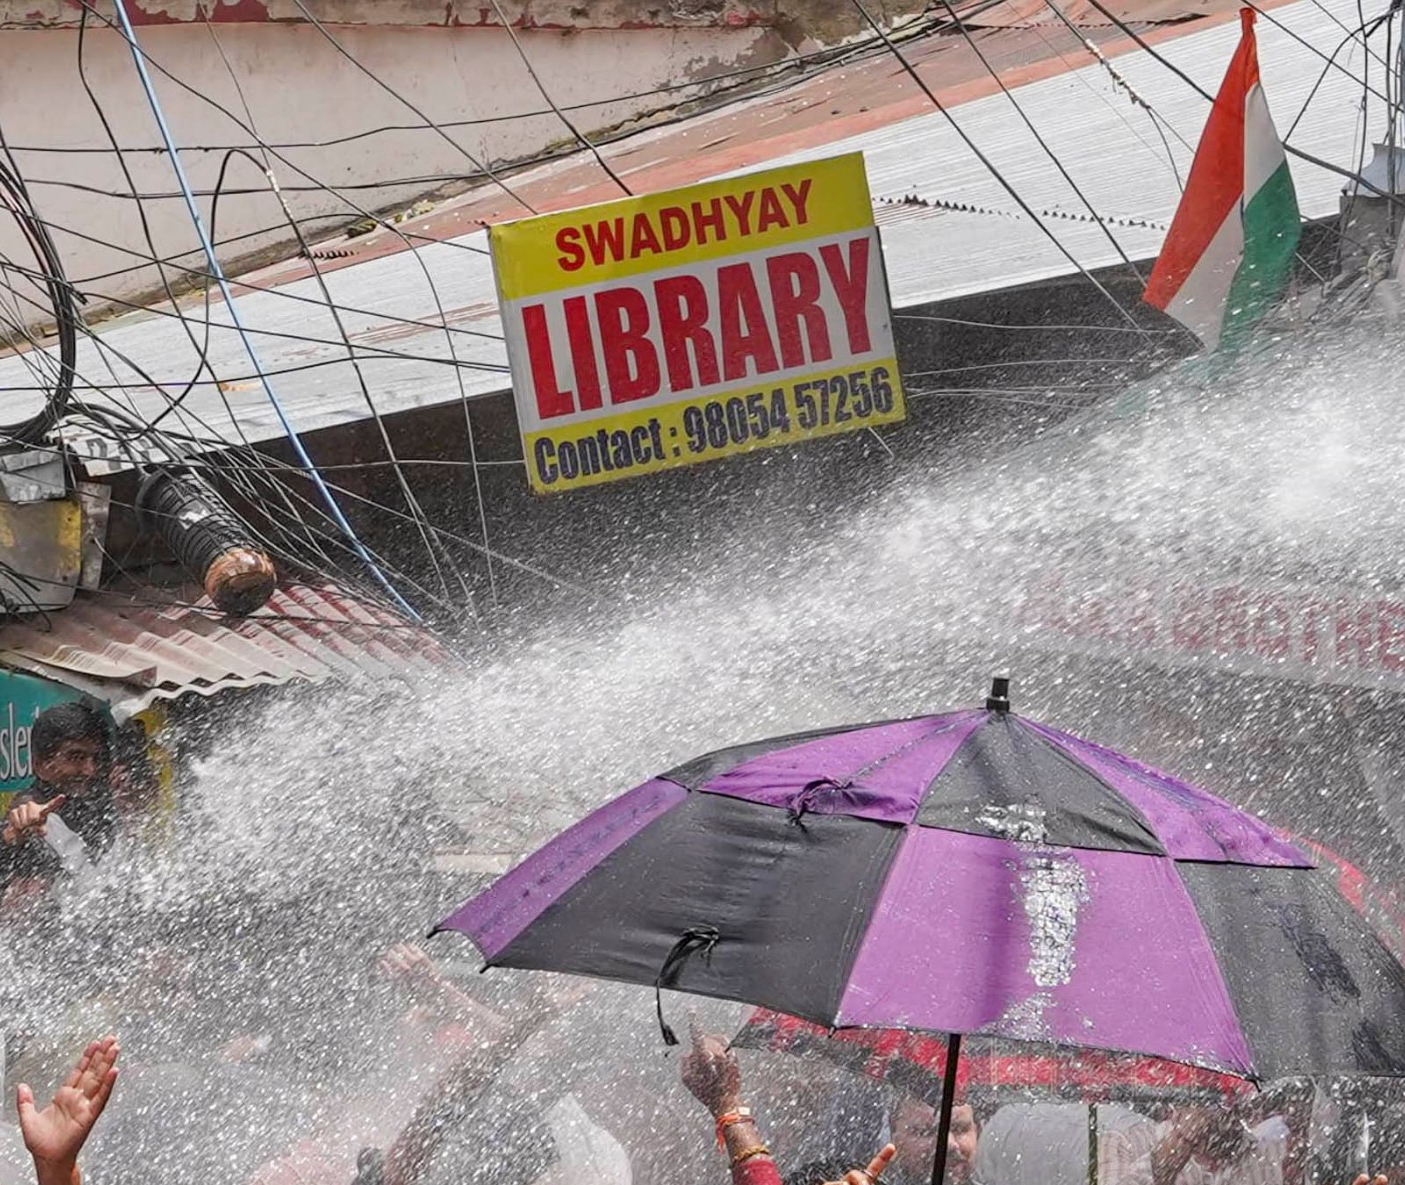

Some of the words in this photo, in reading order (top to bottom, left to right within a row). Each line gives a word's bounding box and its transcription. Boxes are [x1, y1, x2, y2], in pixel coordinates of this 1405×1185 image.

[555, 178, 812, 272] SWADHYAY
[521, 236, 873, 420] LIBRARY
[533, 417, 667, 485] Contact
[683, 386, 791, 454] 98054
[795, 365, 894, 431] 57256
